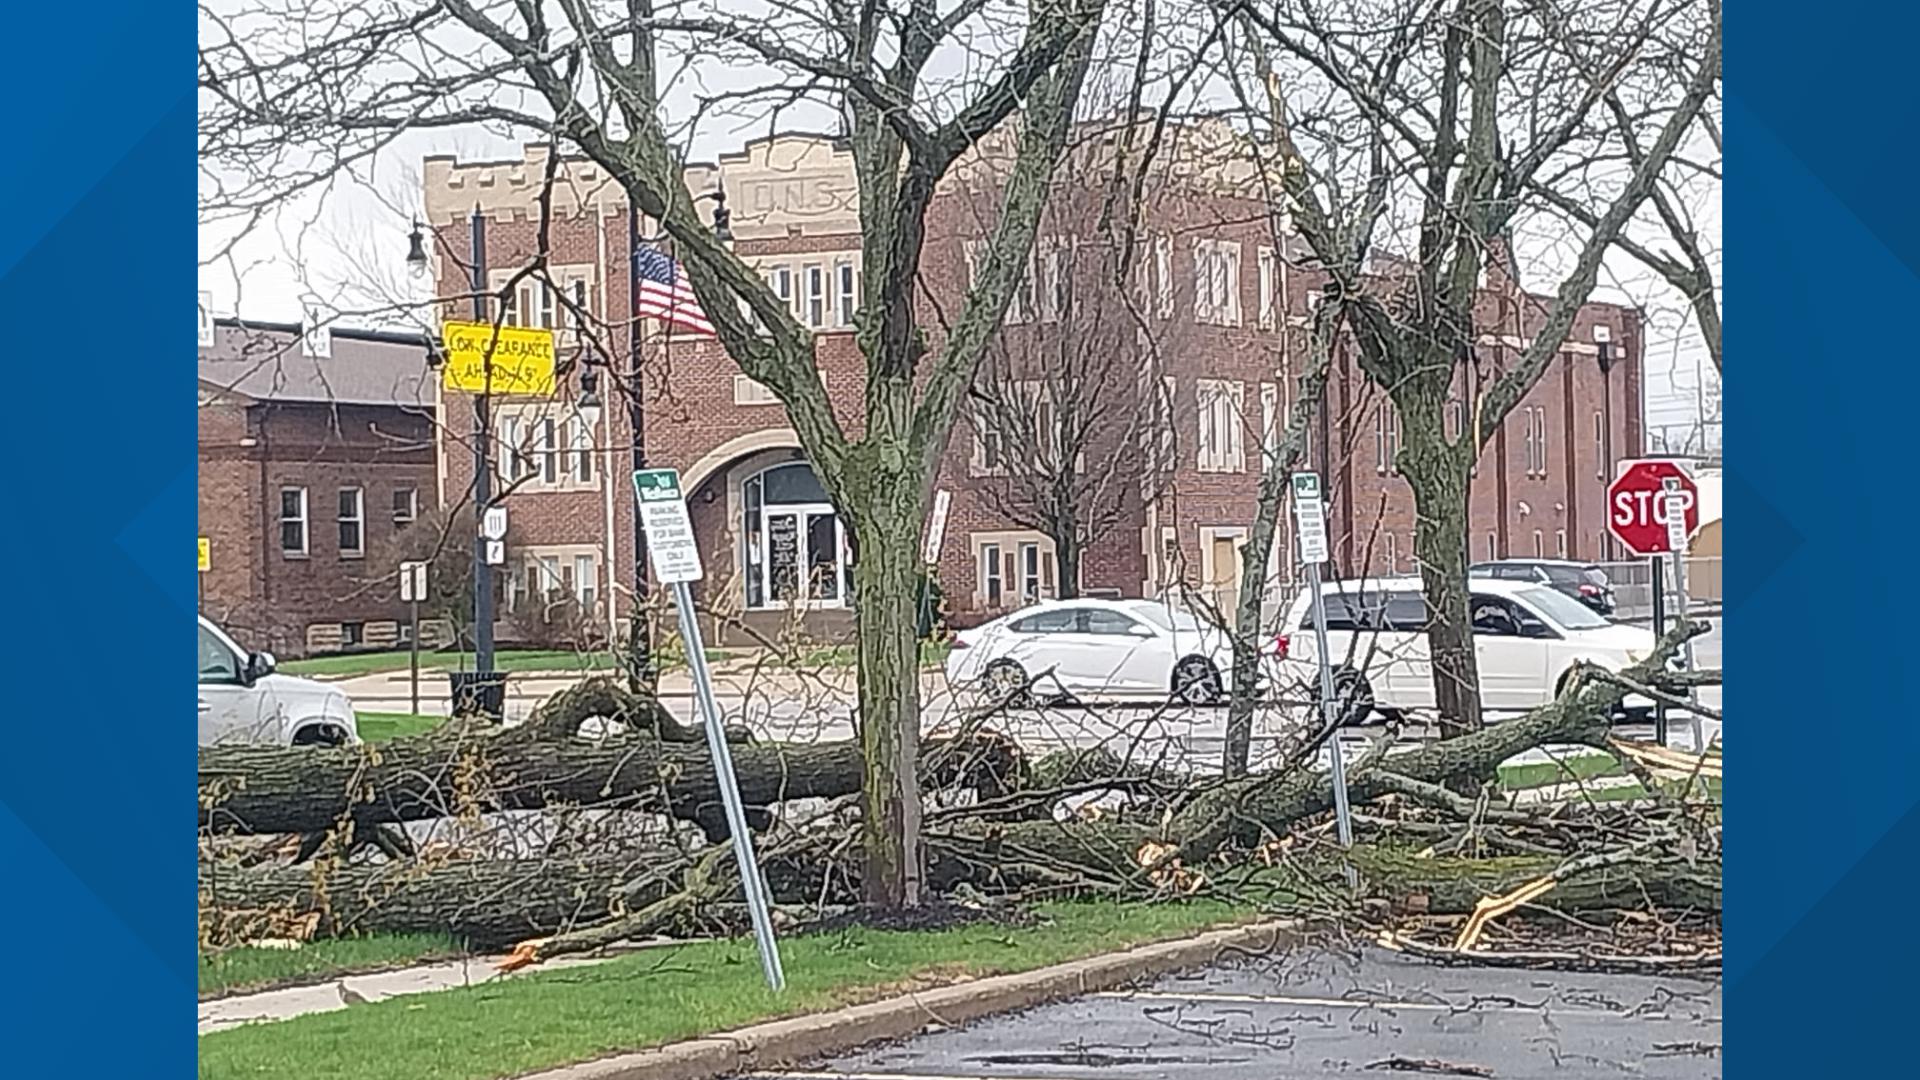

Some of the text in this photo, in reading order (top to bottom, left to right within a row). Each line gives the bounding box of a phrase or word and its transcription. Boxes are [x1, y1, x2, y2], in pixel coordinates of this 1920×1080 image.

[481, 338, 551, 359] CEARANCE
[464, 363, 506, 381] AHAD
[488, 515, 502, 532] 111
